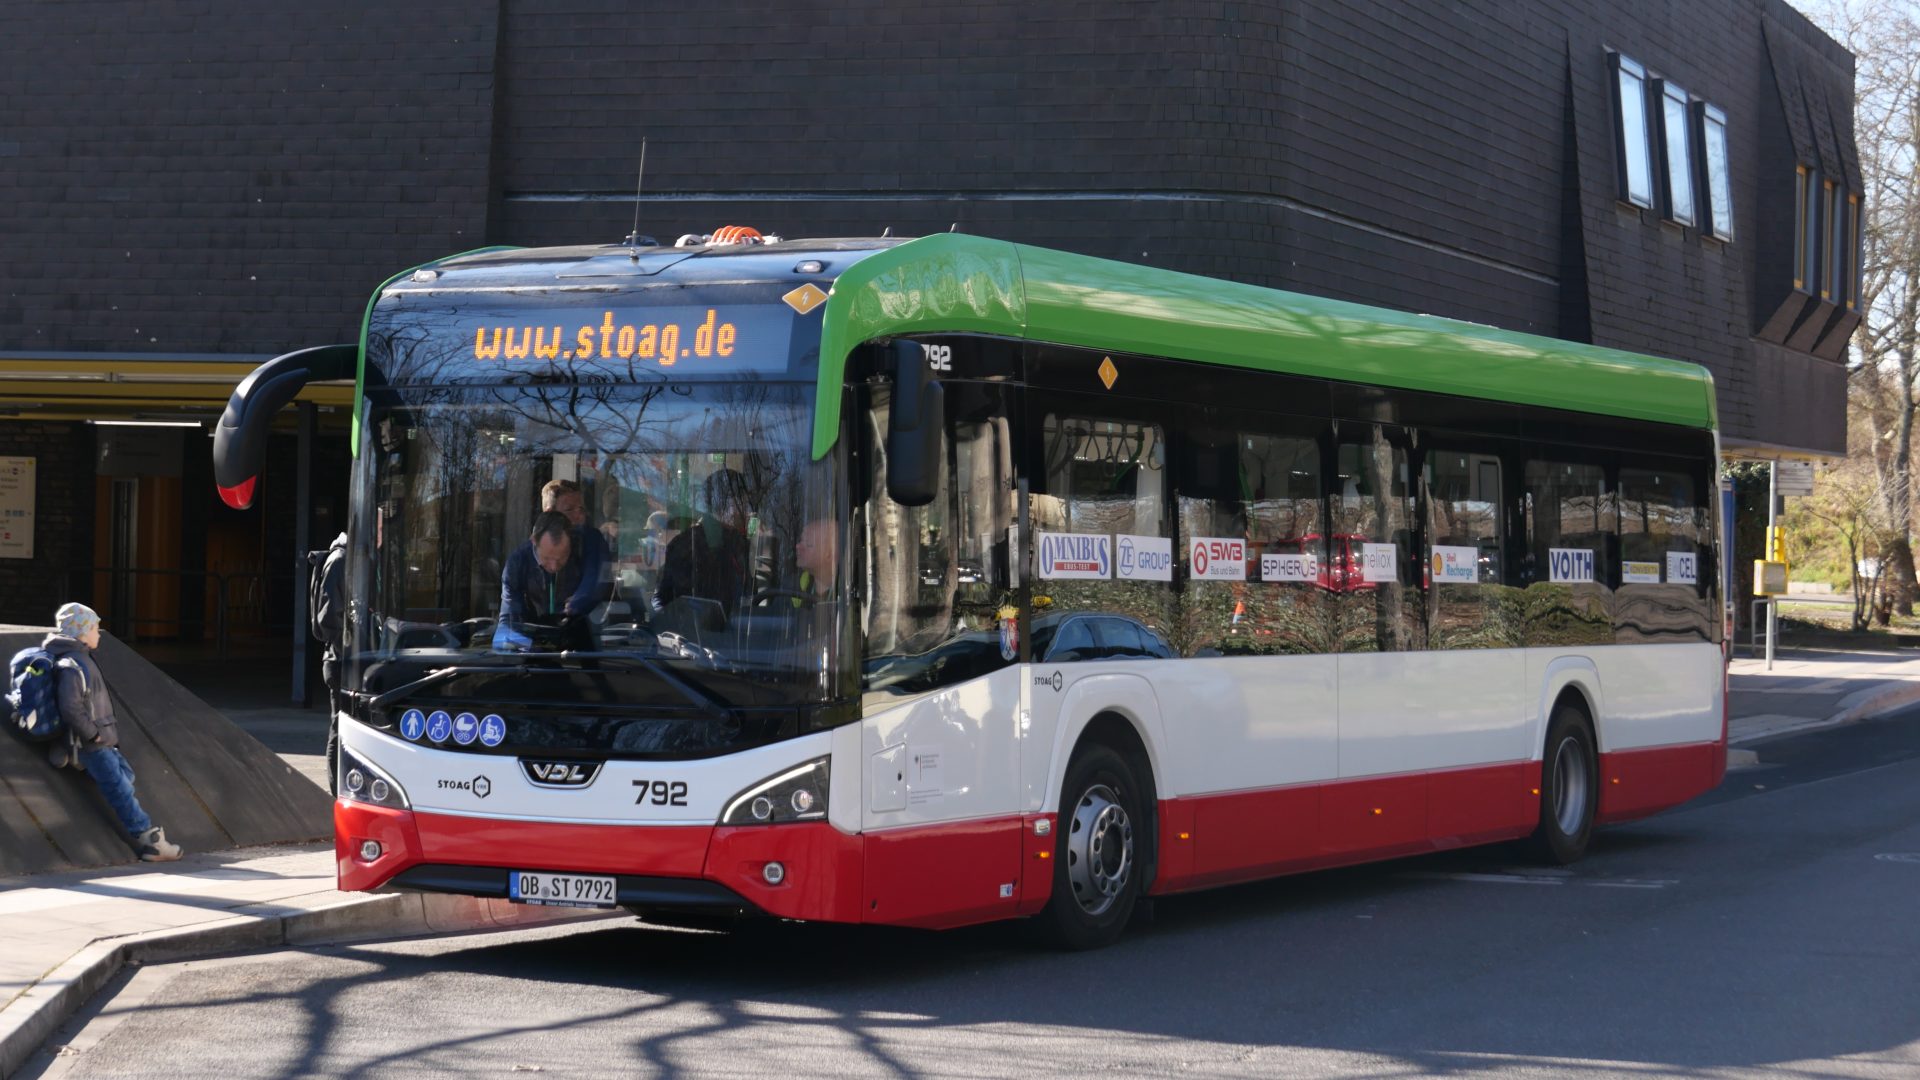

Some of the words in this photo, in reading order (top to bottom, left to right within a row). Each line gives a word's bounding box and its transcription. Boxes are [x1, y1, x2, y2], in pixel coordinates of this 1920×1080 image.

[475, 309, 735, 365] www.stoag.de
[1042, 536, 1108, 576] OMNIBUS
[1119, 545, 1134, 568] ZF
[1138, 551, 1170, 570] GROUP
[1210, 542, 1243, 561] SWB
[1364, 547, 1391, 569] heliox
[1210, 566, 1219, 575] Bus
[1262, 558, 1317, 578] SPHEROS
[1446, 564, 1473, 580] Recharge
[1550, 551, 1593, 580] VOITH
[1034, 677, 1052, 686] STOAG
[532, 763, 586, 781] VDL
[437, 779, 471, 790] STOAG
[632, 780, 688, 806] 792
[520, 875, 540, 896] OB
[551, 877, 571, 898] ST
[575, 879, 613, 901] 9792
